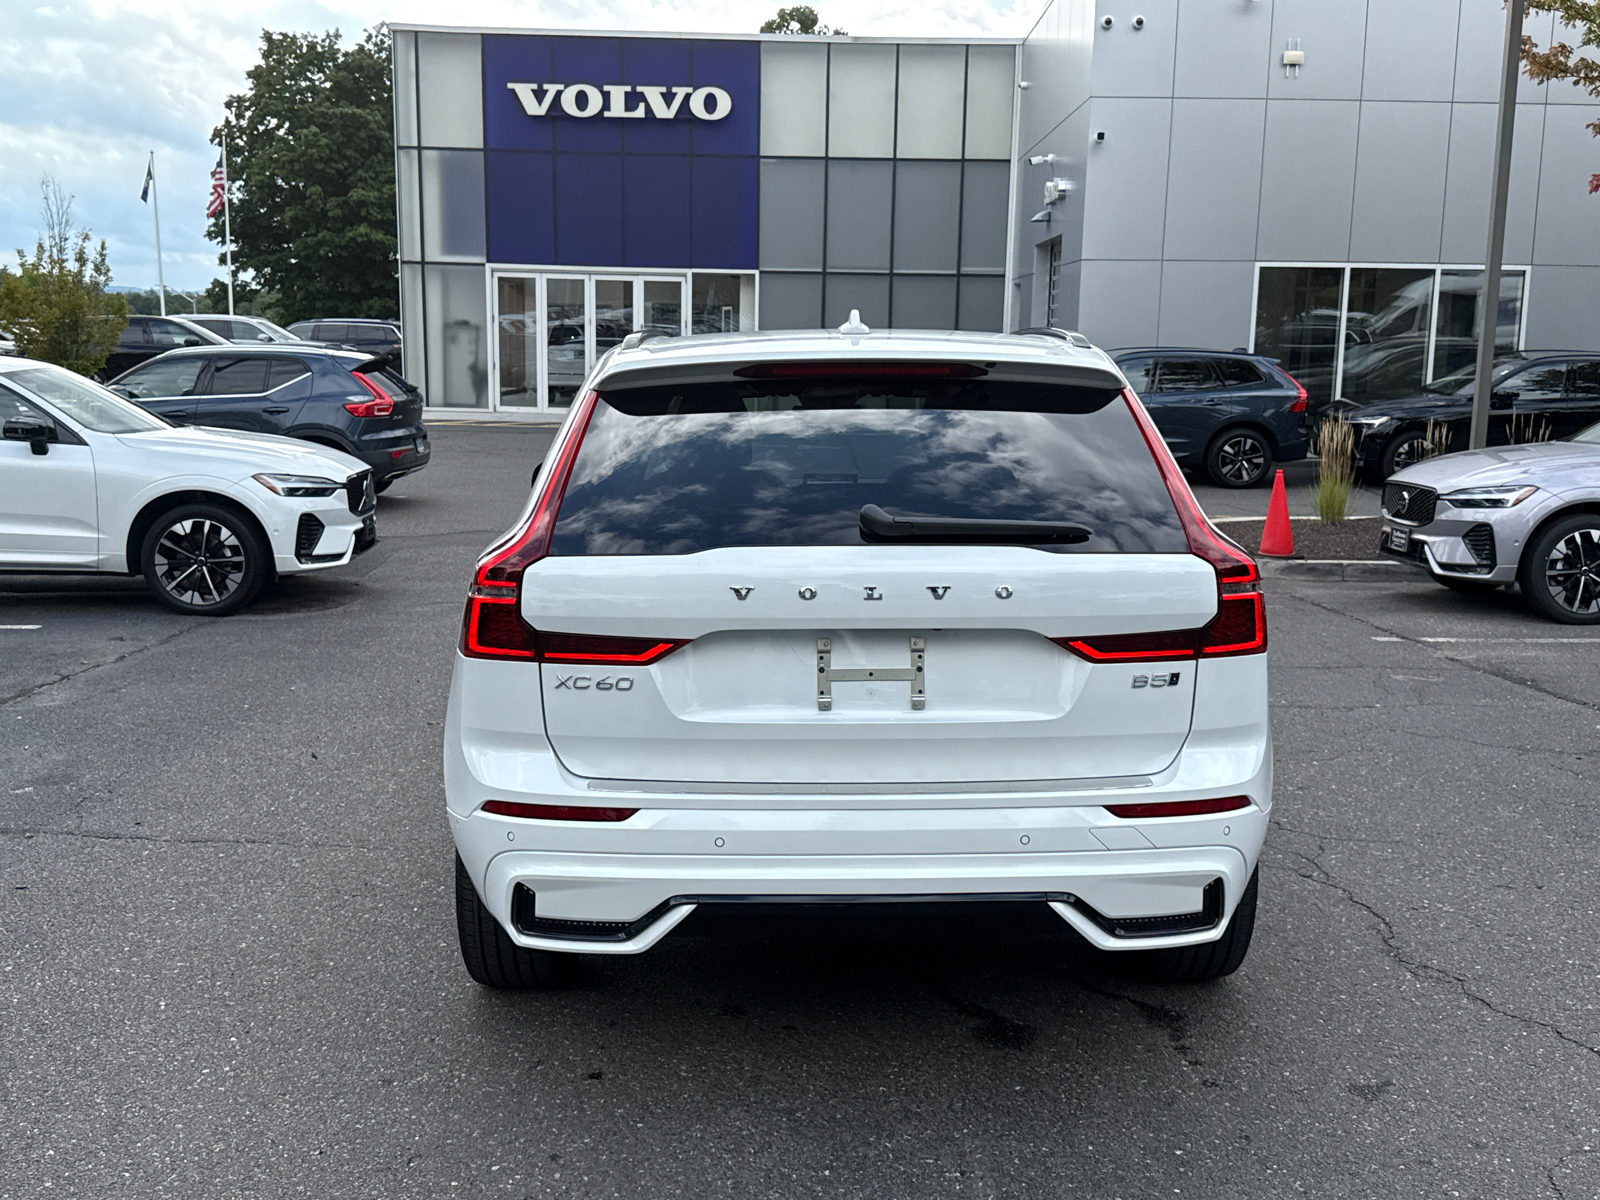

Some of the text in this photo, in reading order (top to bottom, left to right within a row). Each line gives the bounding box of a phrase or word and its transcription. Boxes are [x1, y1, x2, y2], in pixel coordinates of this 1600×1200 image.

[507, 83, 732, 121] VOLVO
[729, 585, 1013, 601] VOLVO
[554, 674, 634, 691] XC60
[1131, 673, 1168, 689] B5
